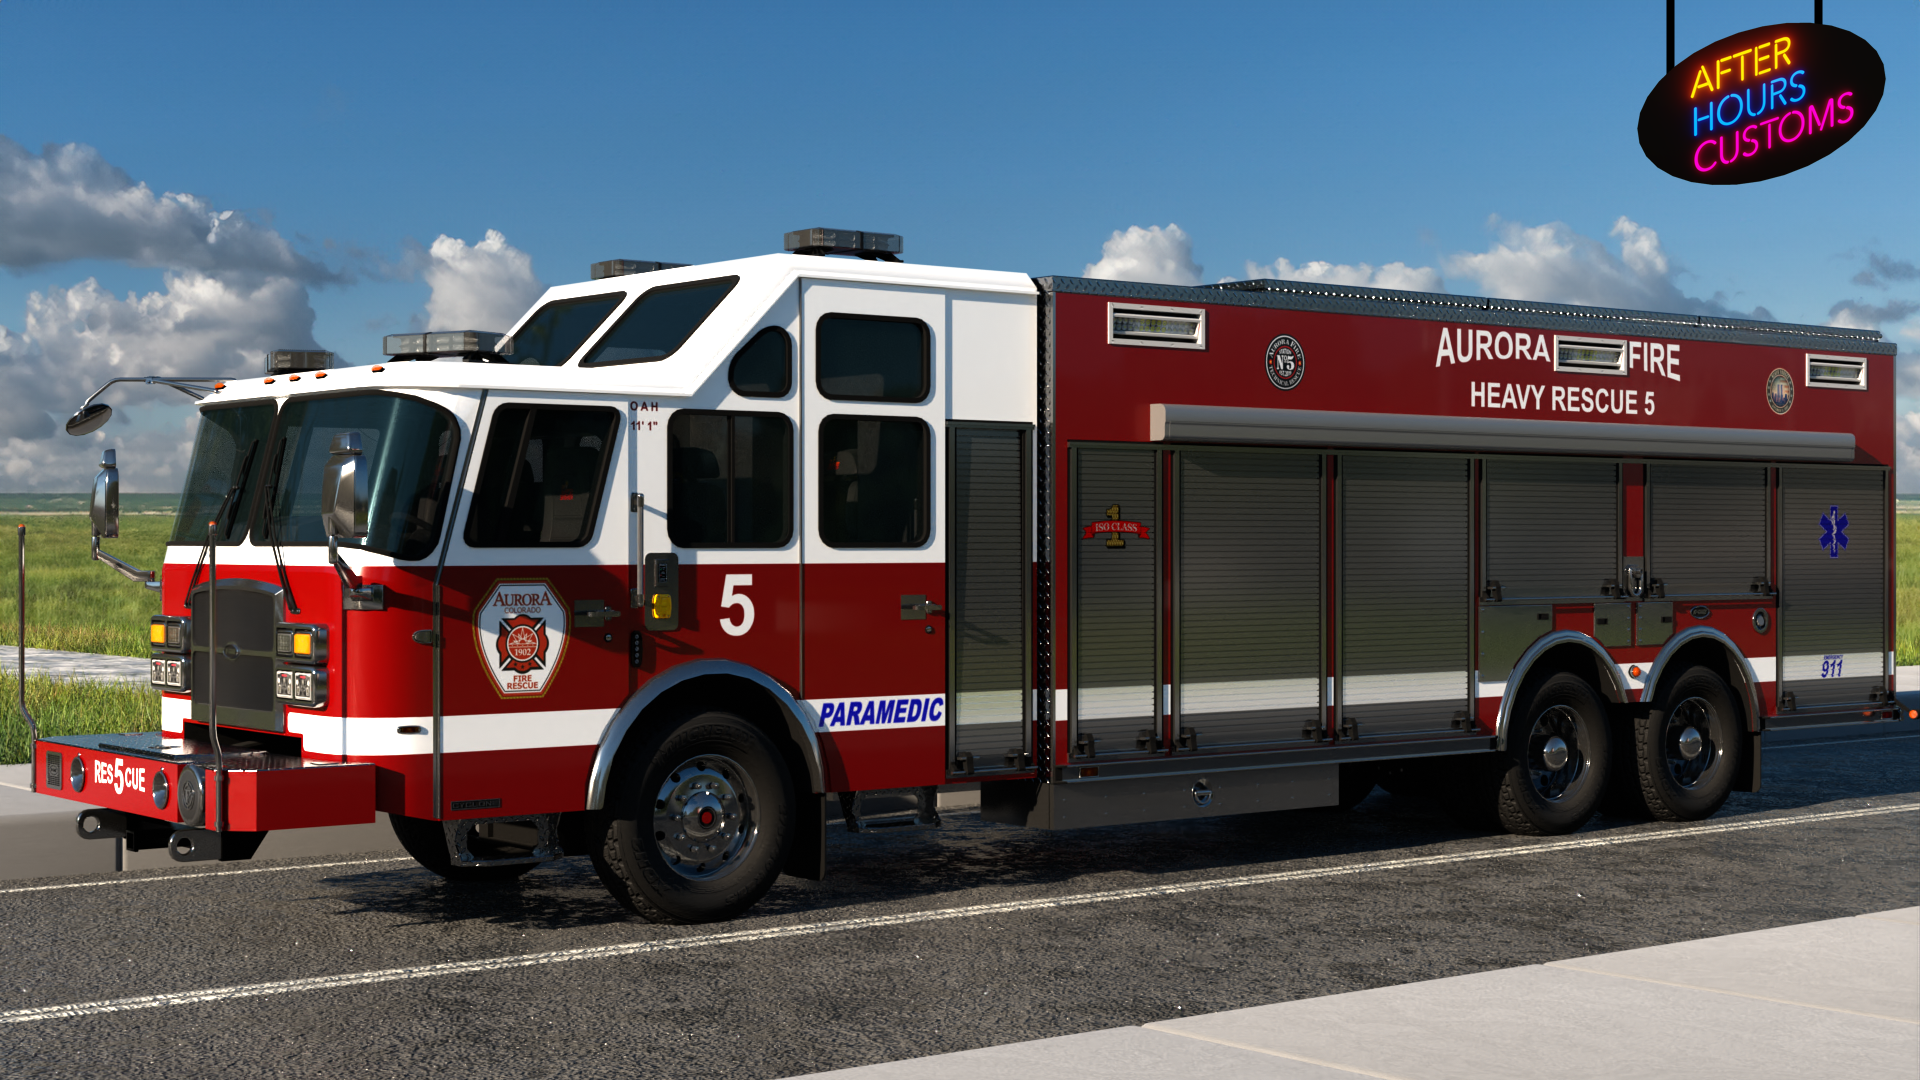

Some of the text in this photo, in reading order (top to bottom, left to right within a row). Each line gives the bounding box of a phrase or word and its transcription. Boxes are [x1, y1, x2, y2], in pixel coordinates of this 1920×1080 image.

[1690, 36, 1791, 98] AFTER
[1693, 69, 1806, 136] HOURS
[1694, 91, 1855, 172] CUSTOMS
[1435, 327, 1681, 382] AURORA FIRE
[1470, 381, 1656, 416] HEAVY RESCUE 5
[1095, 522, 1138, 532] ISO CLASS
[493, 591, 552, 606] AURORA
[719, 573, 755, 637] 5
[514, 648, 531, 656] 1902
[1821, 660, 1843, 678] 911
[818, 697, 944, 728] PARAMEDIC
